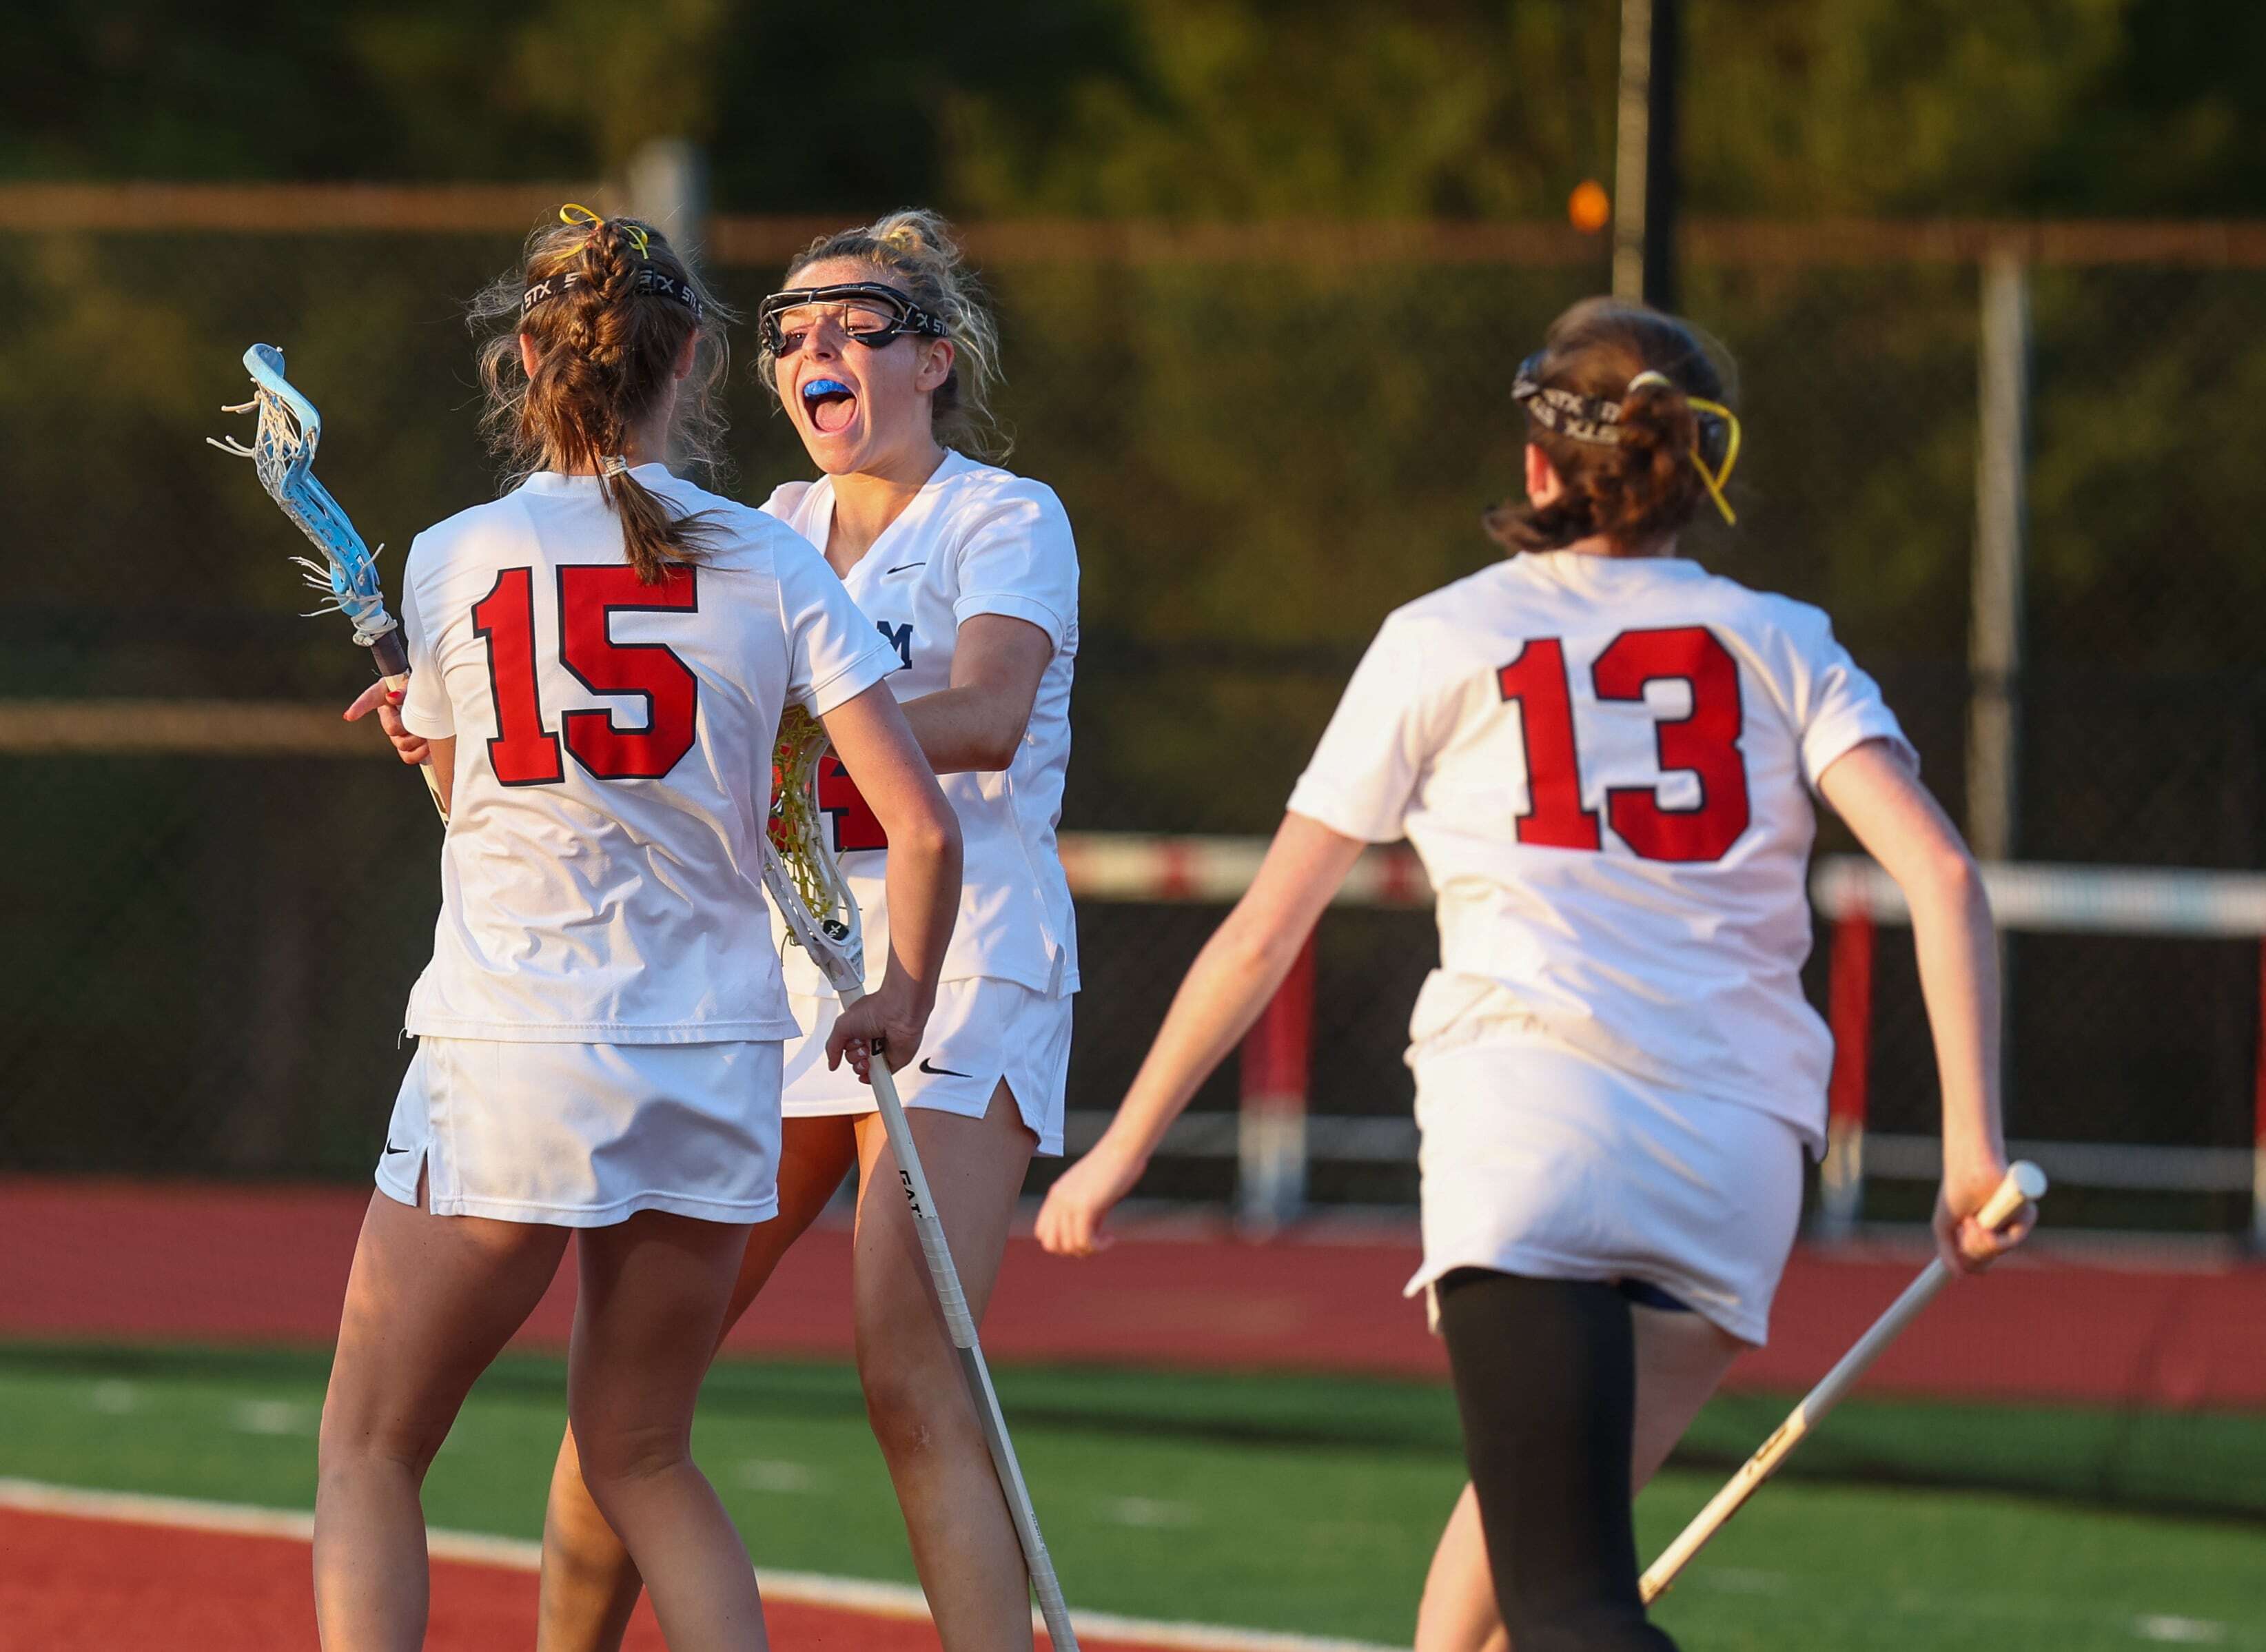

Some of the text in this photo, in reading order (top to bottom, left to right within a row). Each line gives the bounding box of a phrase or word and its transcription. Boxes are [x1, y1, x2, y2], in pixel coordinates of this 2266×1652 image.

[524, 279, 551, 309] STX
[471, 562, 699, 786] 15
[1496, 625, 1750, 862] 13
